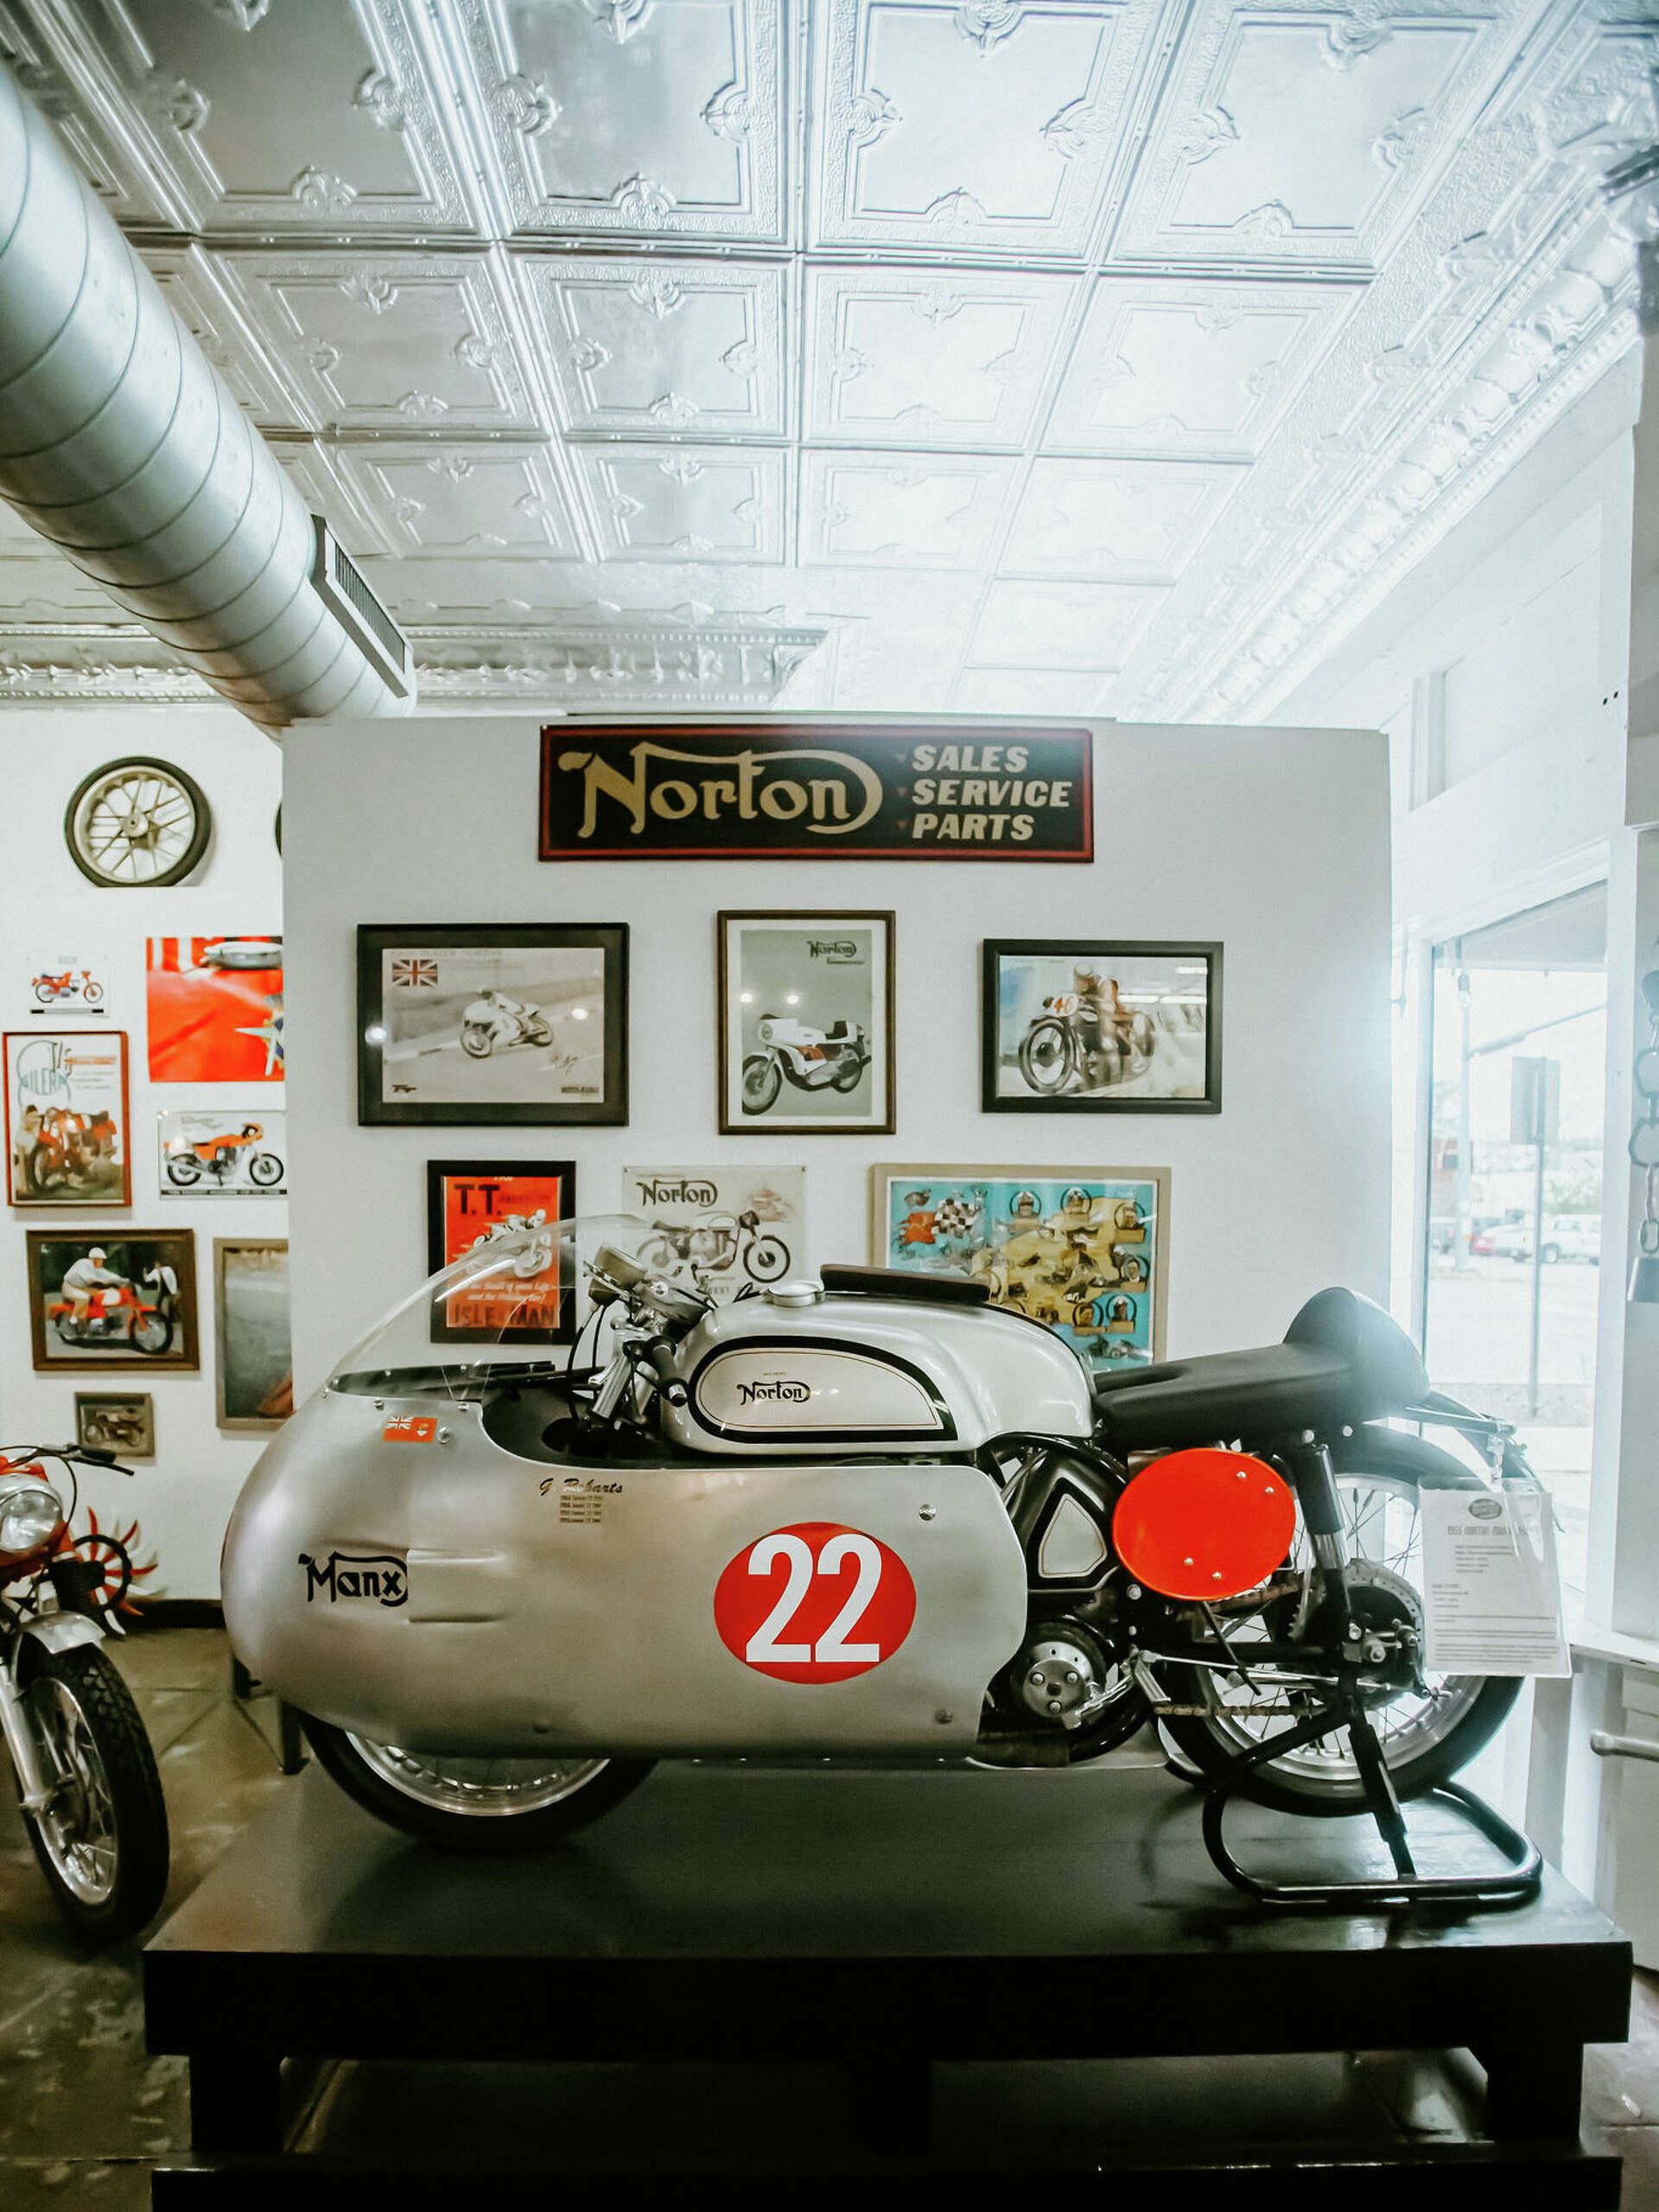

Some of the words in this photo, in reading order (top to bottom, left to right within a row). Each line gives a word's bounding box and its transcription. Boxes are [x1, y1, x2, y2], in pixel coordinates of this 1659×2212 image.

[912, 745, 1029, 773] SALES
[558, 742, 883, 838] Norton
[912, 779, 1072, 807] SERVICE
[912, 813, 1035, 841] PARTS
[806, 940, 857, 957] Norton
[454, 1184, 501, 1216] T.T.
[636, 1179, 717, 1207] Norton
[737, 1381, 811, 1406] Norton
[298, 1550, 409, 1607] Manx
[746, 1533, 882, 1662] 22
